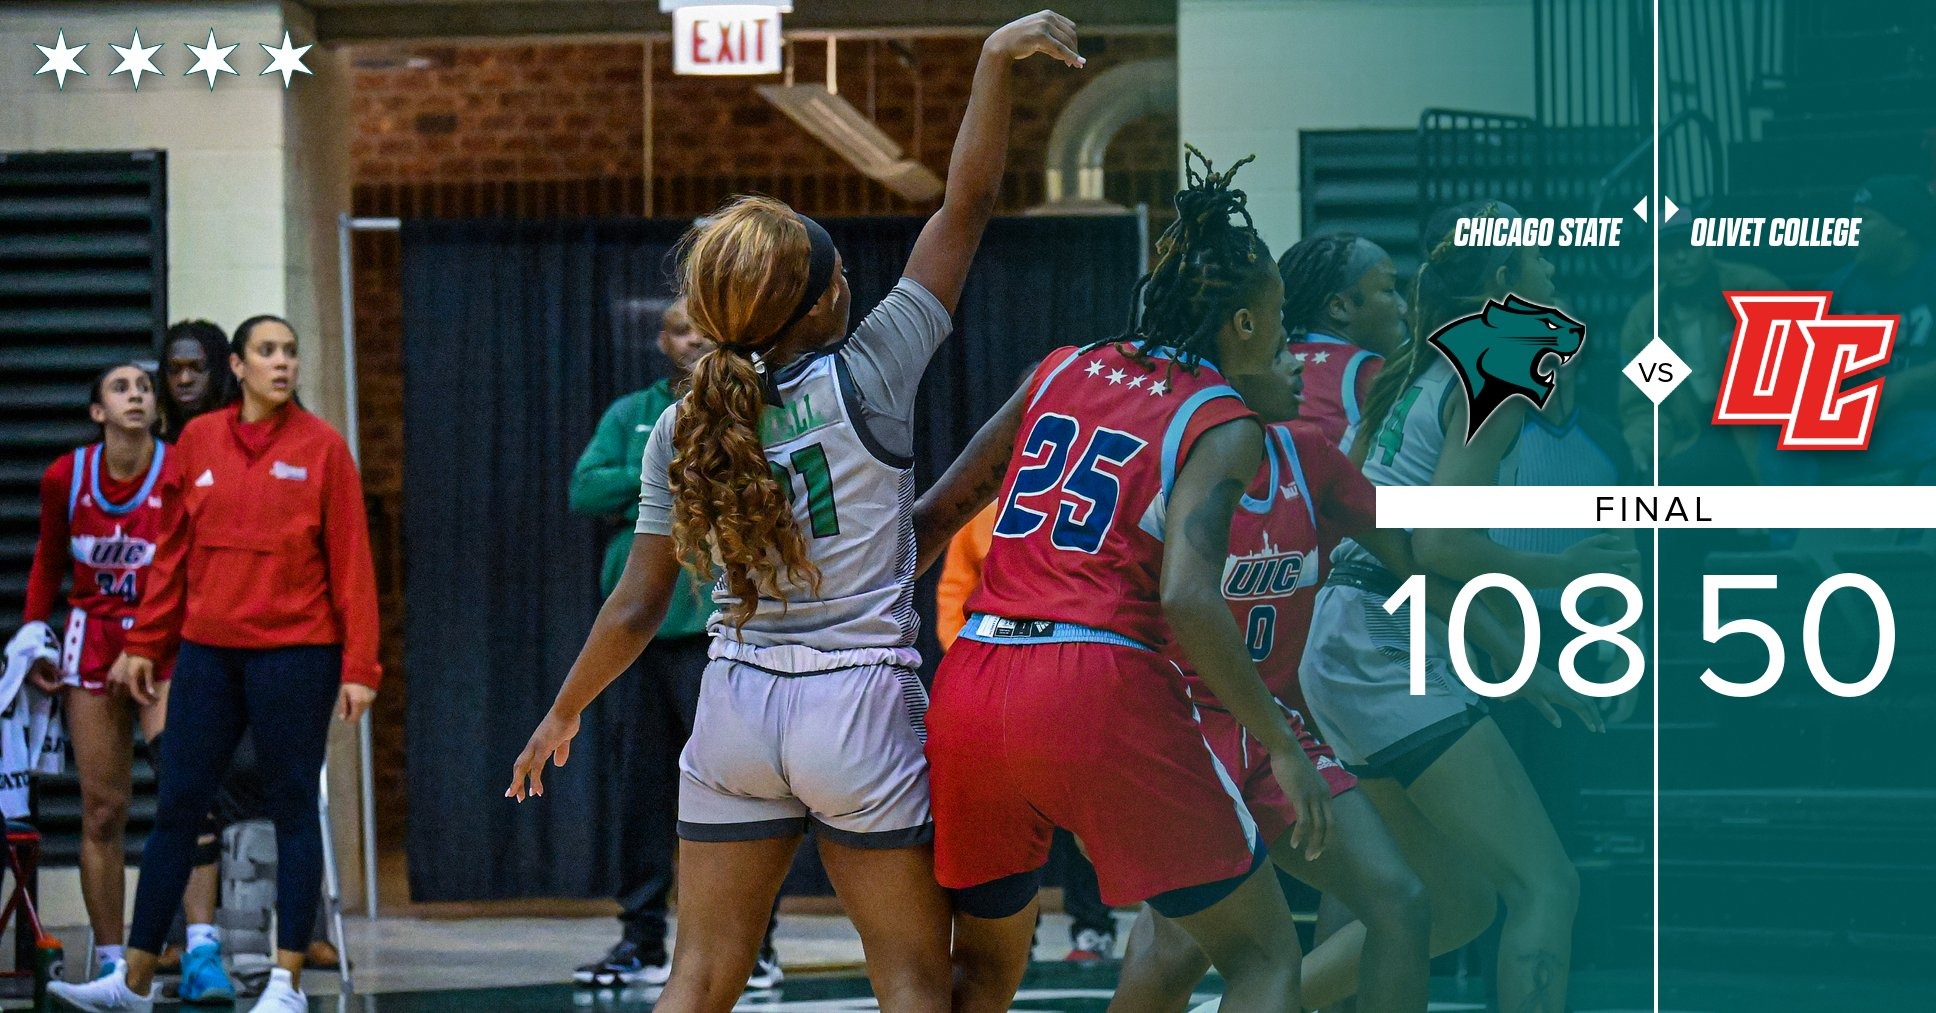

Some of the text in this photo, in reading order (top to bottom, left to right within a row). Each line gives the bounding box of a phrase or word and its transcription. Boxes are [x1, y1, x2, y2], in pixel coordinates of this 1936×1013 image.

[691, 18, 769, 64] EXIT
[994, 411, 1149, 555] 25
[91, 541, 146, 565] UIC
[1225, 555, 1304, 597] UIC
[1246, 604, 1277, 662] 0
